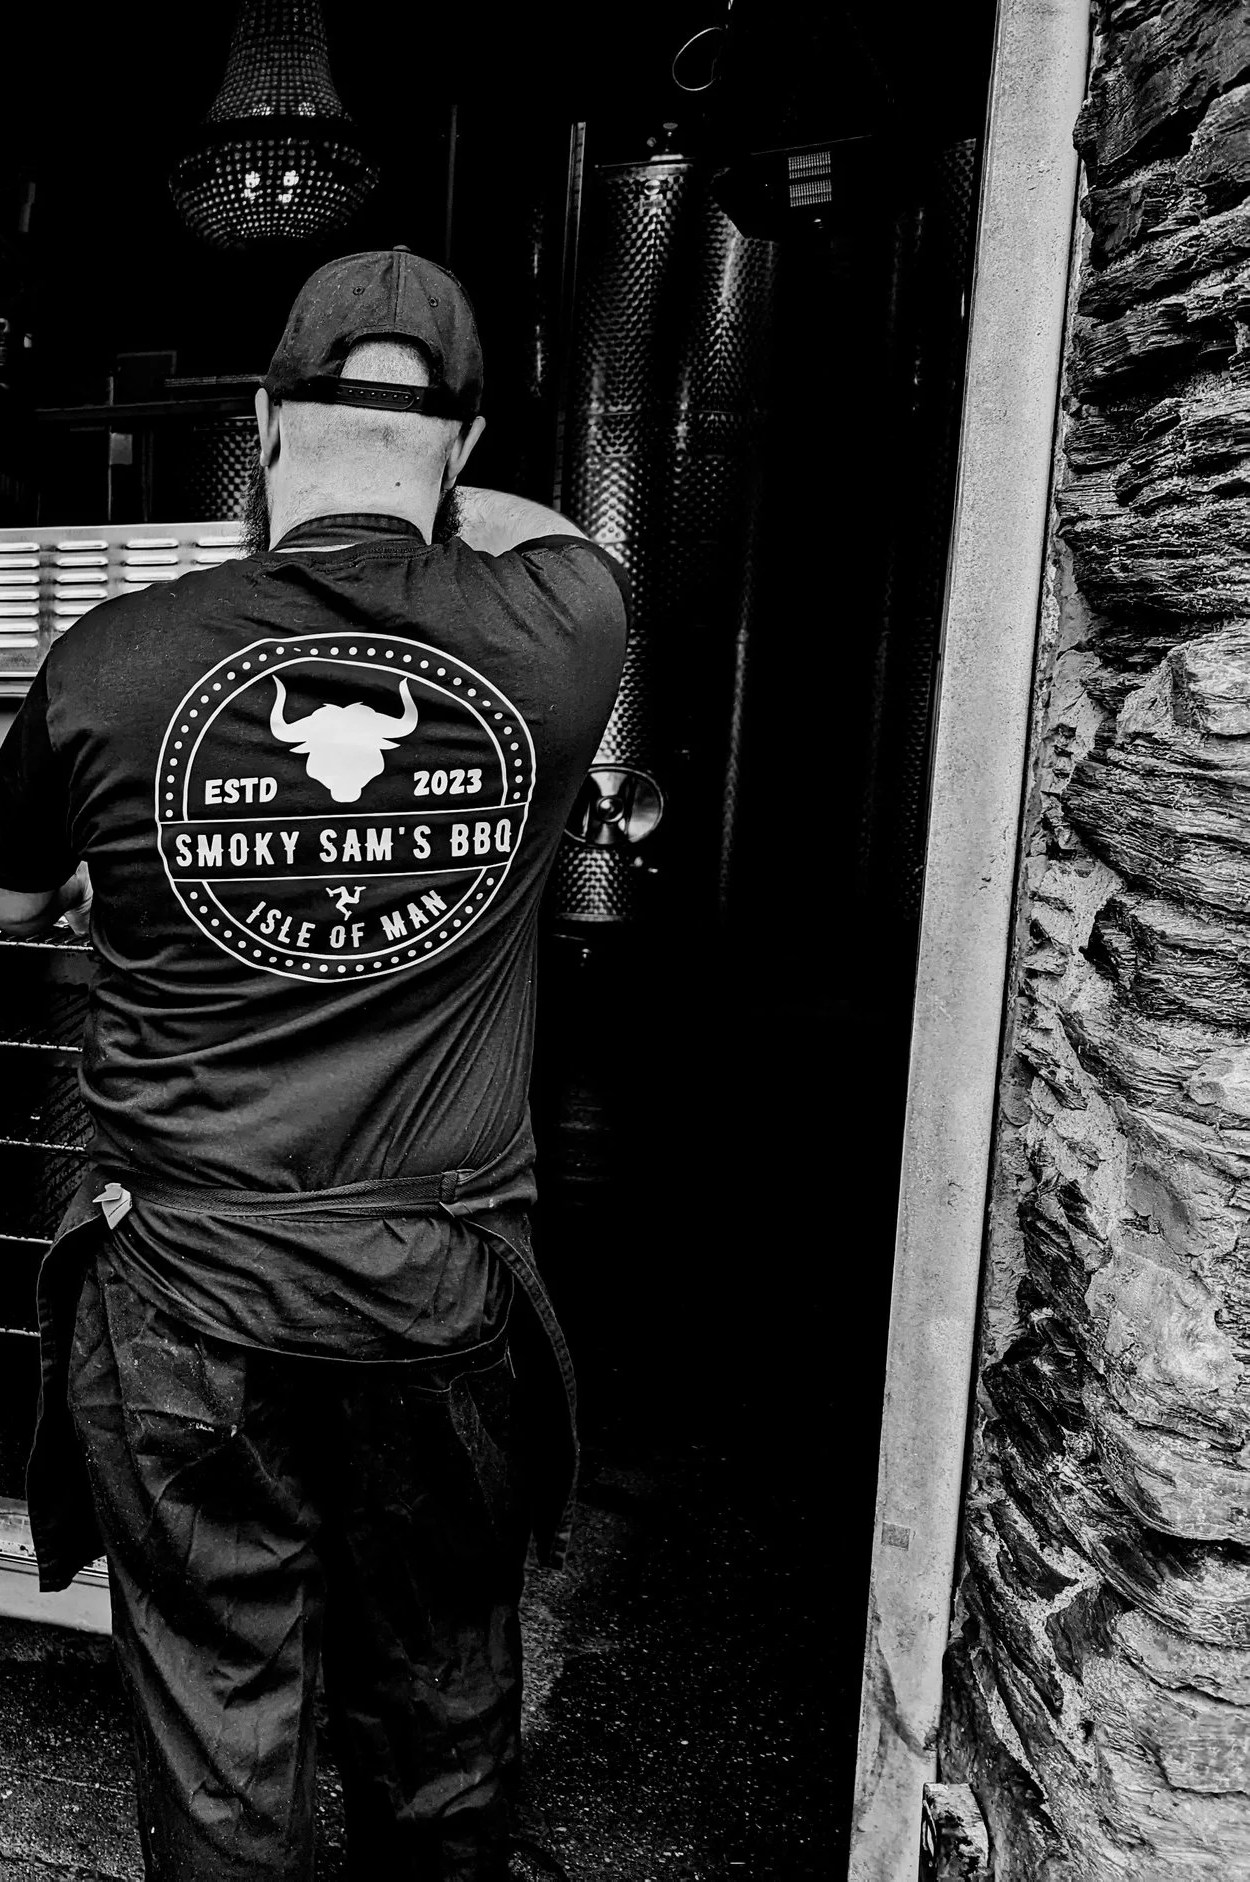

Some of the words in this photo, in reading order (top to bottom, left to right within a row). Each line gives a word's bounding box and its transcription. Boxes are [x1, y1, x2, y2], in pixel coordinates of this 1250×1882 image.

[204, 776, 278, 805] ESTD
[413, 768, 483, 797] 2023
[175, 831, 300, 867] SMOKY
[319, 825, 432, 863] SAM'S
[449, 818, 512, 857] BBQ
[245, 900, 316, 948] ISLE
[329, 922, 365, 949] OF
[379, 889, 448, 941] MAN
